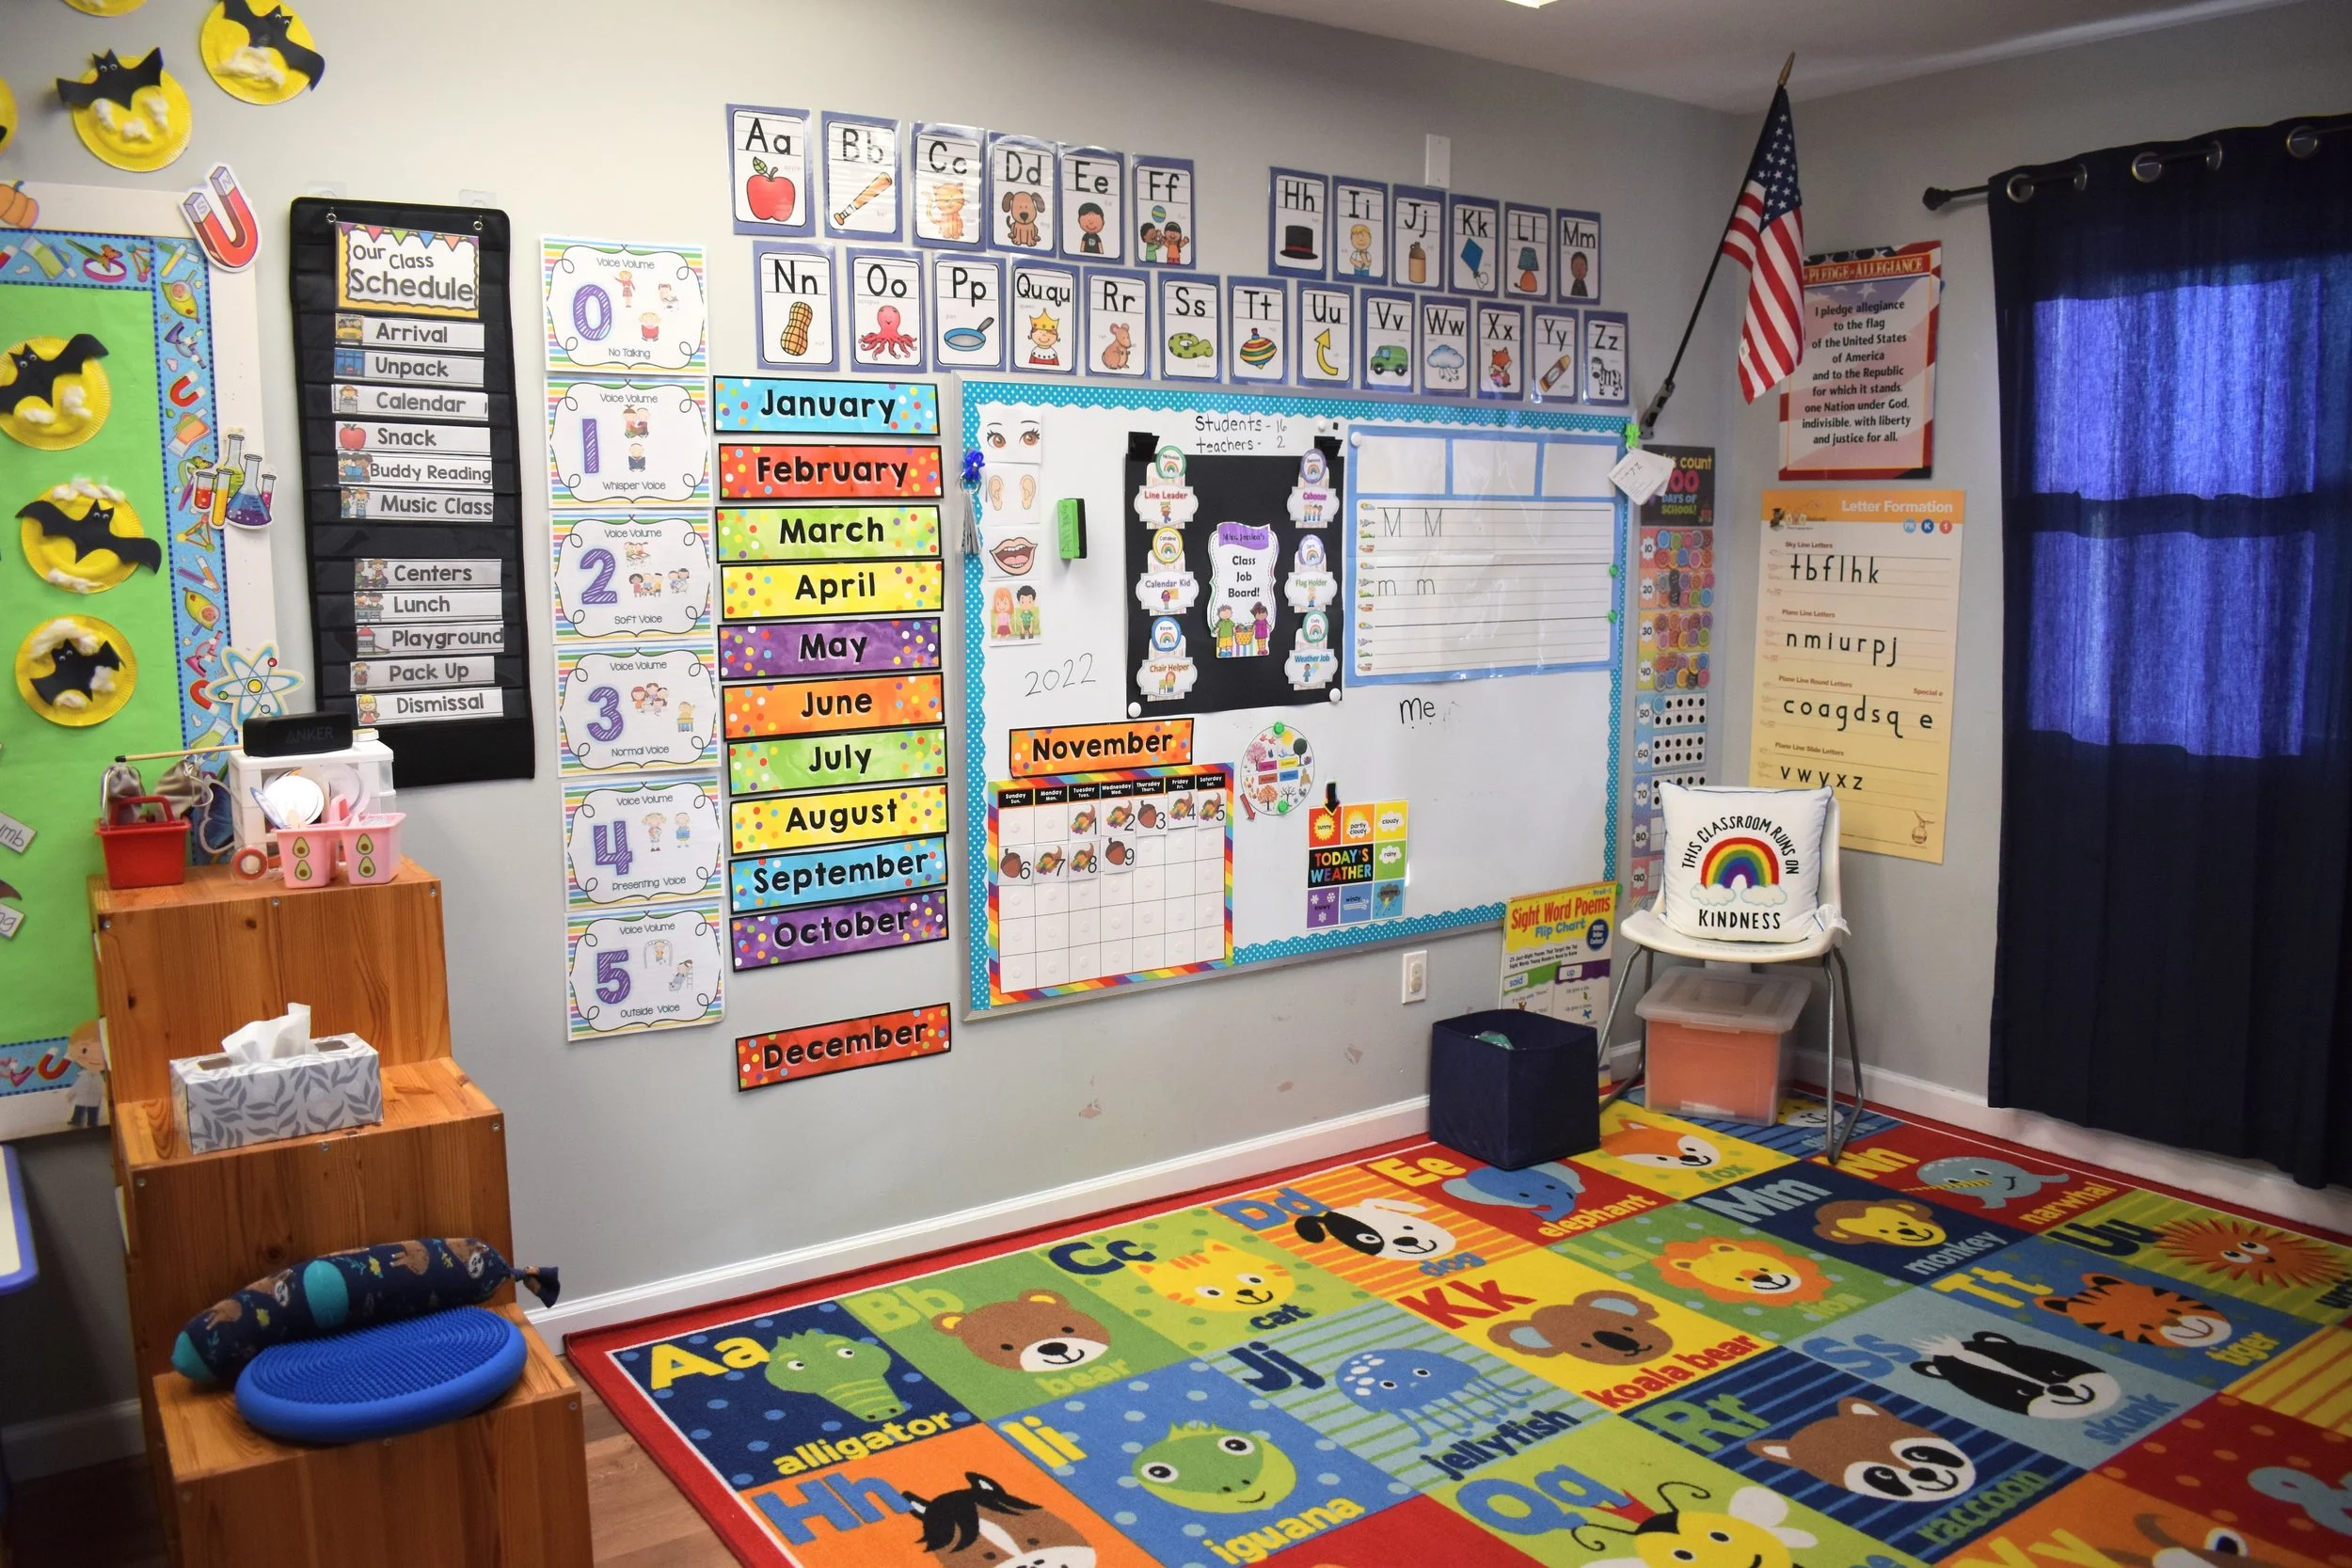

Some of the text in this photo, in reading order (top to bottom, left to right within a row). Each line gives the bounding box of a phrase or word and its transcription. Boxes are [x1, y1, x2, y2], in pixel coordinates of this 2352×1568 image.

[745, 118, 790, 155] Aa
[1006, 150, 1041, 186] Dd
[1283, 180, 1315, 212] Hh
[1564, 221, 1596, 248] Mm
[353, 245, 434, 269] Our Class
[596, 258, 655, 269] Voice Volume
[1856, 258, 1922, 277] ALLEGIANCE
[350, 268, 473, 301] Schedule
[774, 260, 818, 293] Nn
[1103, 281, 1135, 312] Rr
[573, 284, 612, 341] 0
[1376, 303, 1403, 330] Vv
[1816, 301, 1904, 319] I pledge allegiance
[375, 323, 447, 342] Arrival
[1847, 321, 1862, 330] the
[1867, 318, 1884, 329] flag
[1595, 325, 1618, 350] Zz
[1812, 334, 1906, 348] of the United States
[609, 349, 650, 359] No Talking
[1833, 351, 1884, 363] of America
[375, 356, 449, 377] Unpack
[376, 392, 466, 412] Calendar
[760, 389, 896, 423] January
[1277, 420, 1287, 433] 16
[1854, 417, 1876, 426] with
[1879, 416, 1911, 427] liberty
[377, 428, 437, 446] Snack
[1278, 436, 1286, 448] 2
[1814, 434, 1830, 444] and
[1833, 433, 1864, 446] justice
[1867, 433, 1881, 442] for
[371, 463, 490, 483] Buddy Reading
[755, 456, 908, 487] February
[1670, 469, 1699, 493] 00
[603, 481, 665, 491] Whisper Voice
[1303, 492, 1327, 500] Caboose
[1662, 494, 1683, 502] DAYS
[381, 496, 493, 515] Music Class
[1661, 505, 1697, 515] SCHOOL!
[1842, 500, 1953, 513] Letter Formation
[779, 517, 884, 544] March
[1232, 556, 1255, 565] Class
[1645, 545, 1652, 553] 10
[394, 565, 472, 581] Centers
[580, 548, 617, 604] 2
[1236, 572, 1252, 582] Job
[1295, 579, 1308, 588] Flag
[795, 572, 875, 605] April
[1228, 588, 1260, 597] Board!
[393, 595, 450, 612] Lunch
[614, 615, 662, 625] Soft Voice
[391, 627, 503, 648] Playground
[800, 633, 867, 662] May
[389, 663, 469, 682] Pack Up
[1025, 652, 1096, 697] 2022
[1150, 664, 1189, 673] Chair Helper
[397, 693, 484, 713] Dismissal
[587, 687, 624, 741] 3
[802, 691, 872, 718] June
[1640, 709, 1649, 718] 50
[286, 726, 334, 743] ANKER
[809, 744, 871, 773] July
[1033, 732, 1173, 762] November
[786, 800, 898, 833] August
[1091, 803, 1225, 834] 1 2 3 4 5
[594, 821, 632, 876] 4
[1682, 816, 1799, 874] THIS CLASSROOM RUNS ON
[1315, 848, 1369, 867] TODAY'S
[754, 853, 928, 895] September
[1311, 864, 1372, 883] WEATHER
[1511, 897, 1610, 932] Sight Word Poems
[1699, 910, 1780, 928] KINDNESS
[774, 909, 910, 947] October
[1535, 918, 1585, 940] Flip Chart
[596, 950, 630, 1004] 5
[1509, 975, 1523, 987] said
[621, 1004, 679, 1018] Outside Voice
[763, 1021, 928, 1069] December
[2018, 1179, 2115, 1224] narwhal
[1538, 1194, 1658, 1238] elephant
[1419, 1249, 1486, 1278] dog
[1903, 1230, 2008, 1275] monkey
[1251, 1303, 1312, 1330] cat
[2205, 1332, 2281, 1366] tiger
[1035, 1357, 1131, 1395] bear
[1581, 1335, 1761, 1409] koala bear
[2084, 1393, 2180, 1447] skunk
[773, 1411, 956, 1475] alligator
[1420, 1407, 1582, 1481] jellyfish
[1915, 1466, 2054, 1546] raccoon
[1202, 1495, 1366, 1566] iguana
